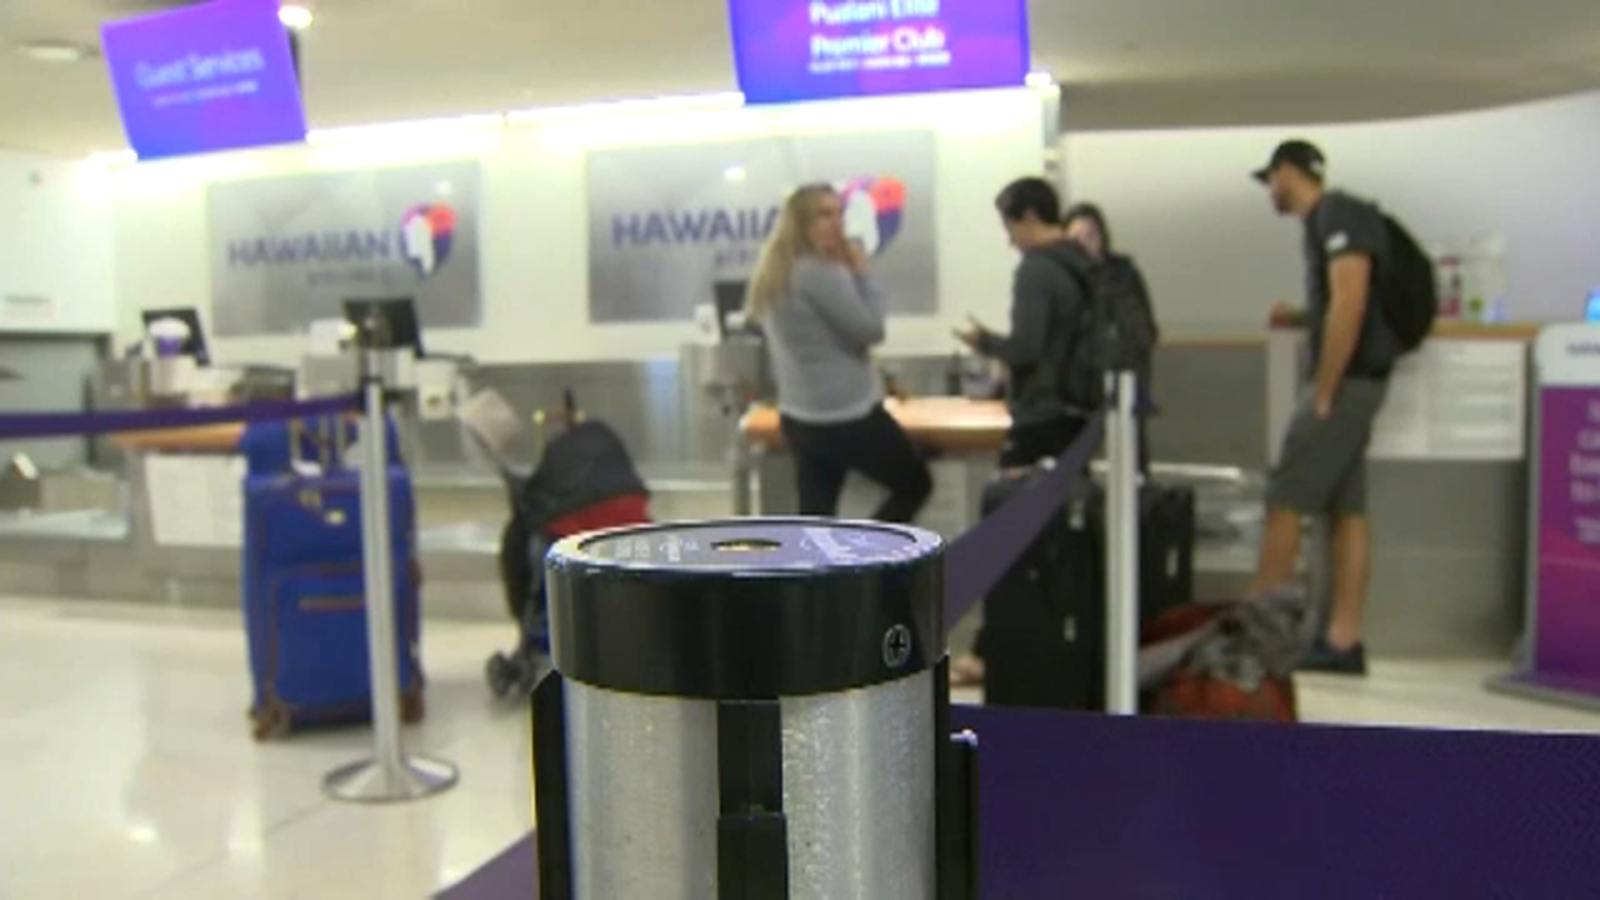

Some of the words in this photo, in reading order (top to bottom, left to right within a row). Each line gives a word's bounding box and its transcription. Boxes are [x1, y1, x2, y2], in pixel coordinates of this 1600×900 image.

[810, 33, 889, 57] Premier
[892, 26, 947, 51] Club
[136, 59, 187, 90] Guest
[187, 49, 265, 80] Services
[612, 206, 781, 245] HAWAIIA
[228, 229, 391, 267] HAWAIIAN
